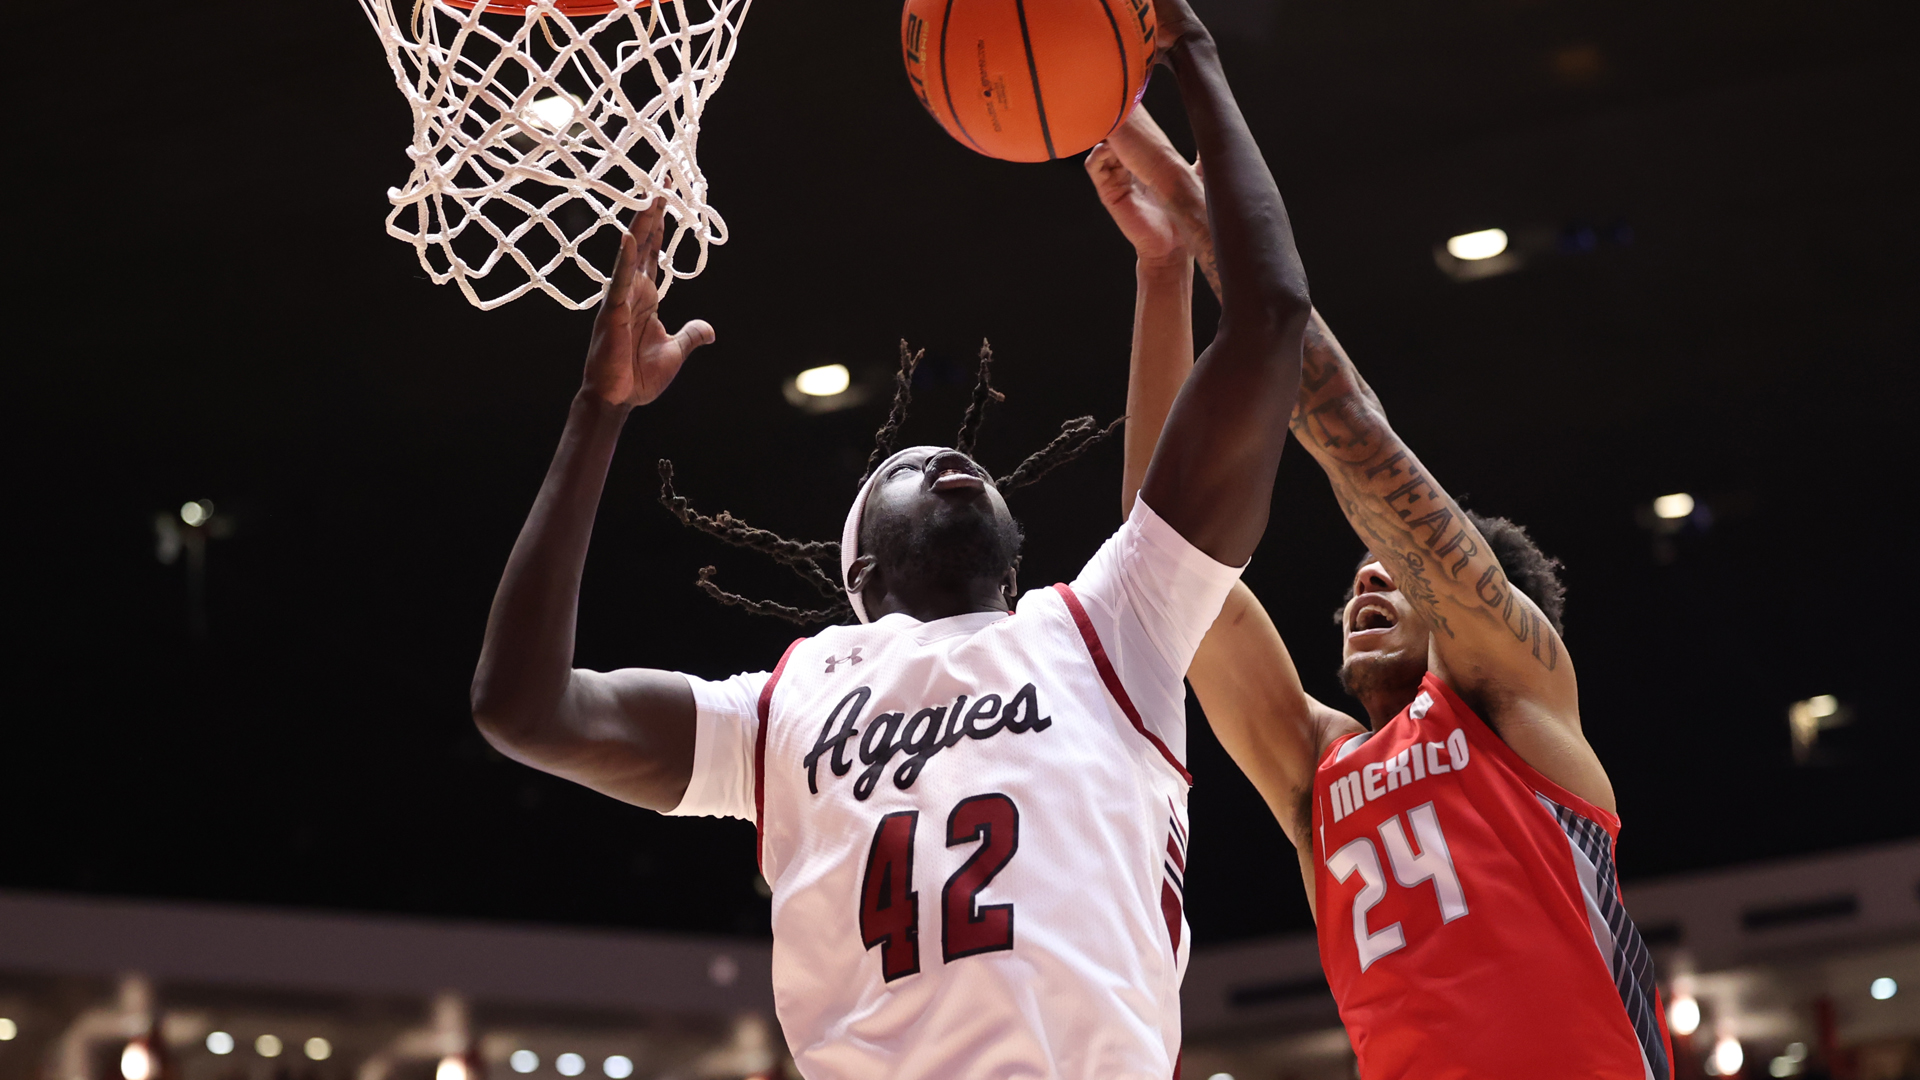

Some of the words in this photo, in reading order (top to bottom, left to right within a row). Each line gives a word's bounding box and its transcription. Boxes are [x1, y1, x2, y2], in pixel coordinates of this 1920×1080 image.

[1365, 451, 1478, 579] FEAR
[1475, 564, 1558, 672] GOD
[803, 682, 1052, 801] Aggies
[1329, 727, 1471, 824] MEXICO
[859, 792, 1020, 984] 42
[1326, 800, 1470, 974] 24
